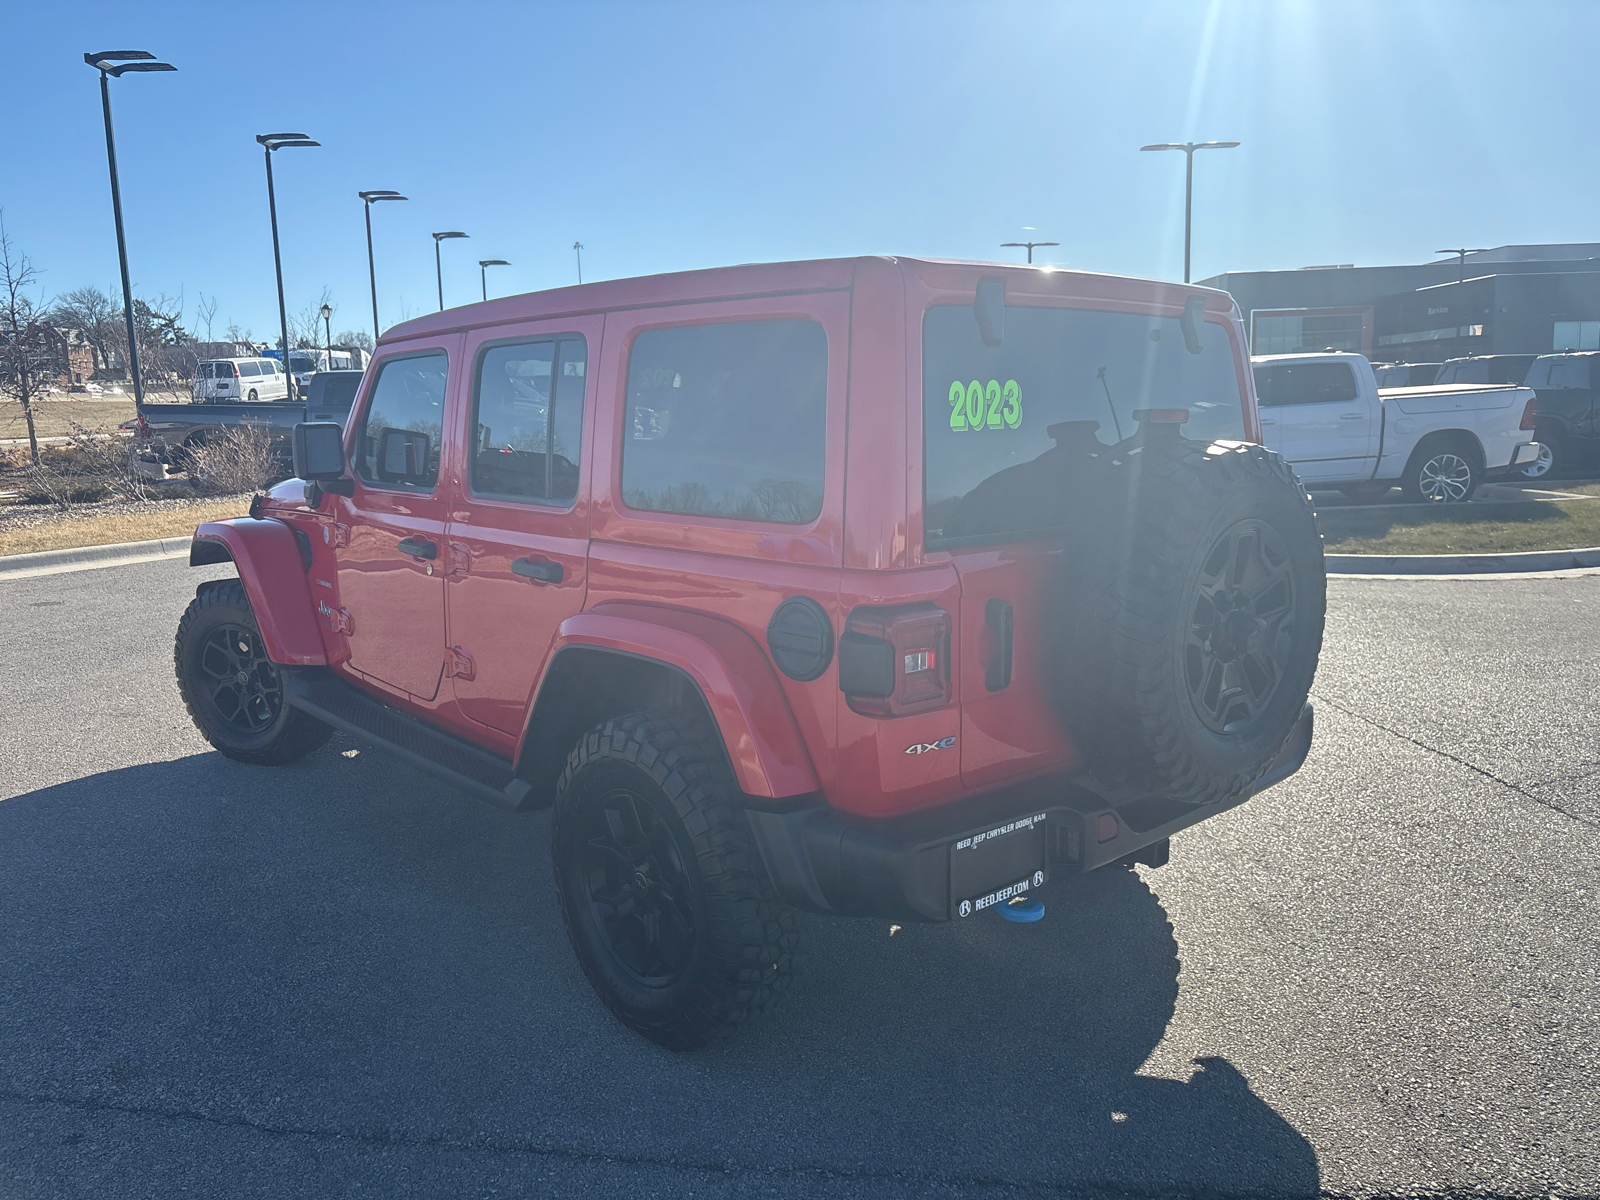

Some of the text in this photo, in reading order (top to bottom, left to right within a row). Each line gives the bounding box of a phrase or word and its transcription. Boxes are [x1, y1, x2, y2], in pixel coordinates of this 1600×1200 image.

[949, 379, 1023, 432] 2023
[956, 813, 1046, 850] REED JEEP CHRYSLER DODGE RAM
[975, 880, 1029, 911] REEDJEEP.COM
